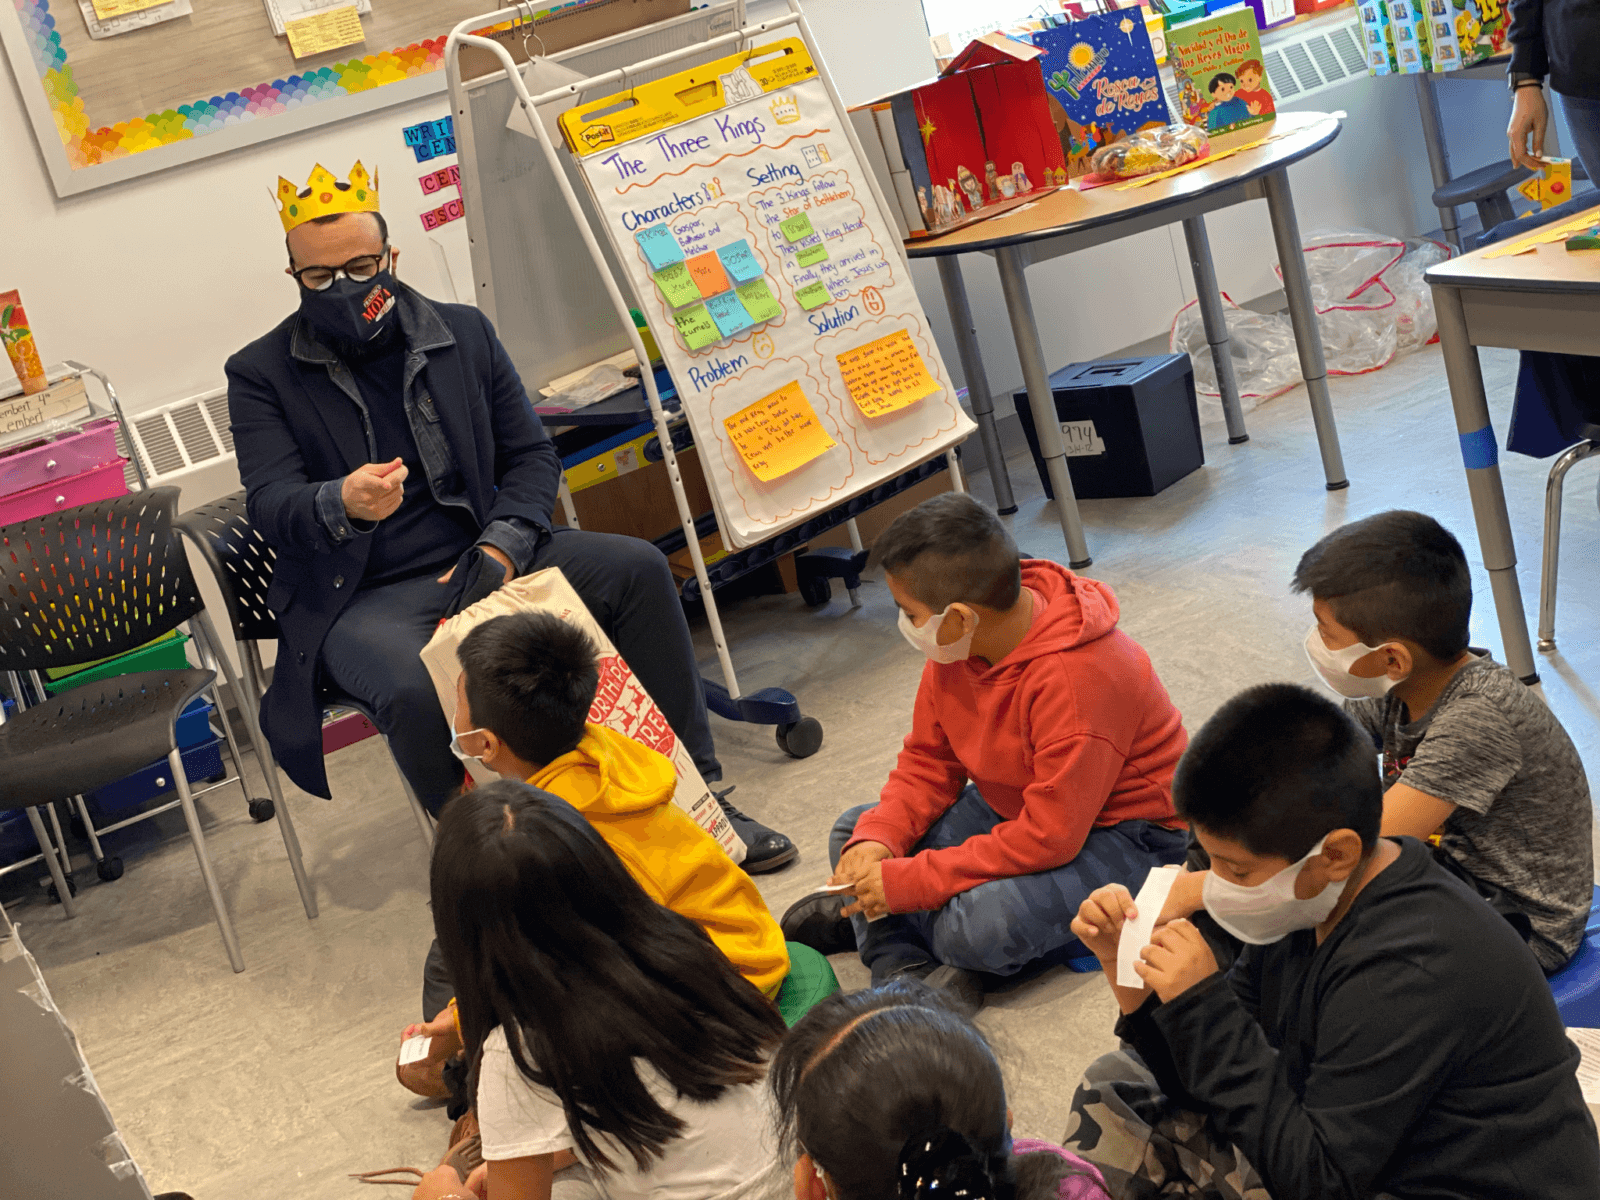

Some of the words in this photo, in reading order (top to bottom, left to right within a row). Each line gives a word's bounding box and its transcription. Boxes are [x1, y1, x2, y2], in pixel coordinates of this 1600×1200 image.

[1178, 40, 1207, 56] Navidad
[1216, 33, 1223, 45] el
[1238, 28, 1248, 39] de
[1181, 57, 1195, 68] los
[1196, 50, 1222, 65] Reyes
[1223, 42, 1250, 55] Magos
[1092, 76, 1140, 100] Rosca
[1095, 97, 1116, 117] de
[1114, 87, 1159, 112] Reyes
[405, 117, 452, 143] WRI
[601, 152, 647, 180] The
[645, 133, 711, 162] Three
[714, 115, 766, 144] Kings
[746, 162, 804, 187] Setting
[756, 199, 774, 211] The
[776, 192, 786, 204] 3
[785, 188, 811, 202] Kings
[812, 180, 836, 191] follow
[764, 214, 781, 226] the
[782, 206, 800, 219] Star
[803, 201, 812, 211] of
[813, 190, 851, 207] Bethlehem
[424, 201, 464, 228] ESC
[622, 191, 704, 231] Characters
[673, 219, 705, 235] Gaspar,
[708, 222, 721, 236] and
[771, 229, 782, 241] to
[776, 243, 799, 257] They
[800, 233, 822, 248] visited
[824, 228, 845, 243] King
[785, 261, 795, 269] in
[820, 263, 839, 276] they
[839, 249, 866, 267] arrived
[869, 248, 879, 256] in
[825, 276, 851, 291] where
[849, 263, 875, 277] Jesus
[362, 288, 392, 324] MOYA
[808, 305, 859, 335] Solution
[687, 355, 749, 393] Problem
[1062, 425, 1092, 445] 974
[588, 678, 620, 722] ORTH
